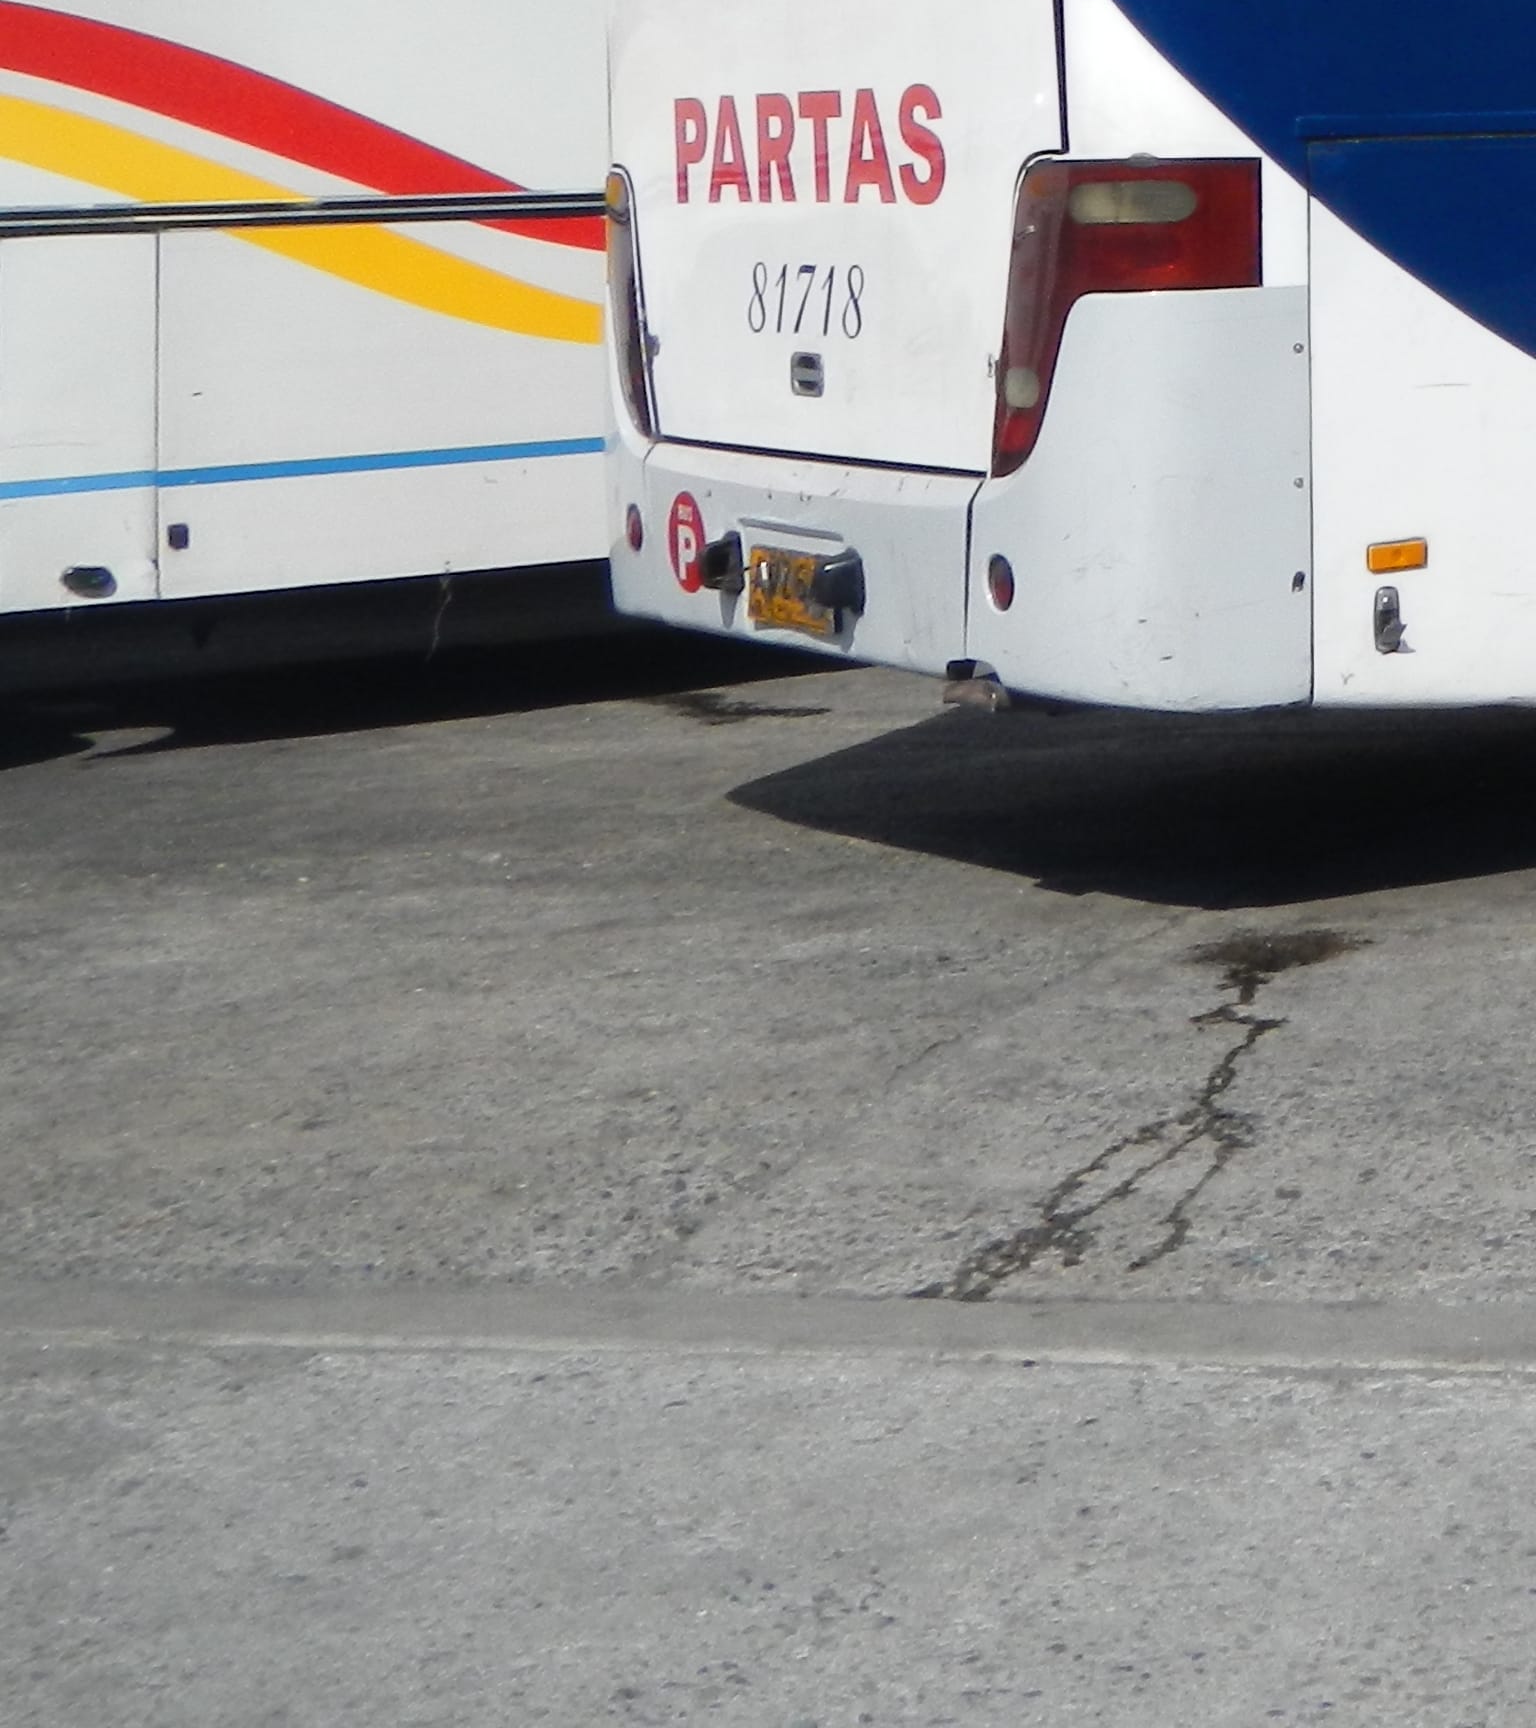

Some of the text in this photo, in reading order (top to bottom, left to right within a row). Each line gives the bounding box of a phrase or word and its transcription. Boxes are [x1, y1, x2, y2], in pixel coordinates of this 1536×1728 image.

[673, 82, 947, 206] PARTAS
[747, 260, 865, 339] 81718
[677, 524, 697, 581] P
